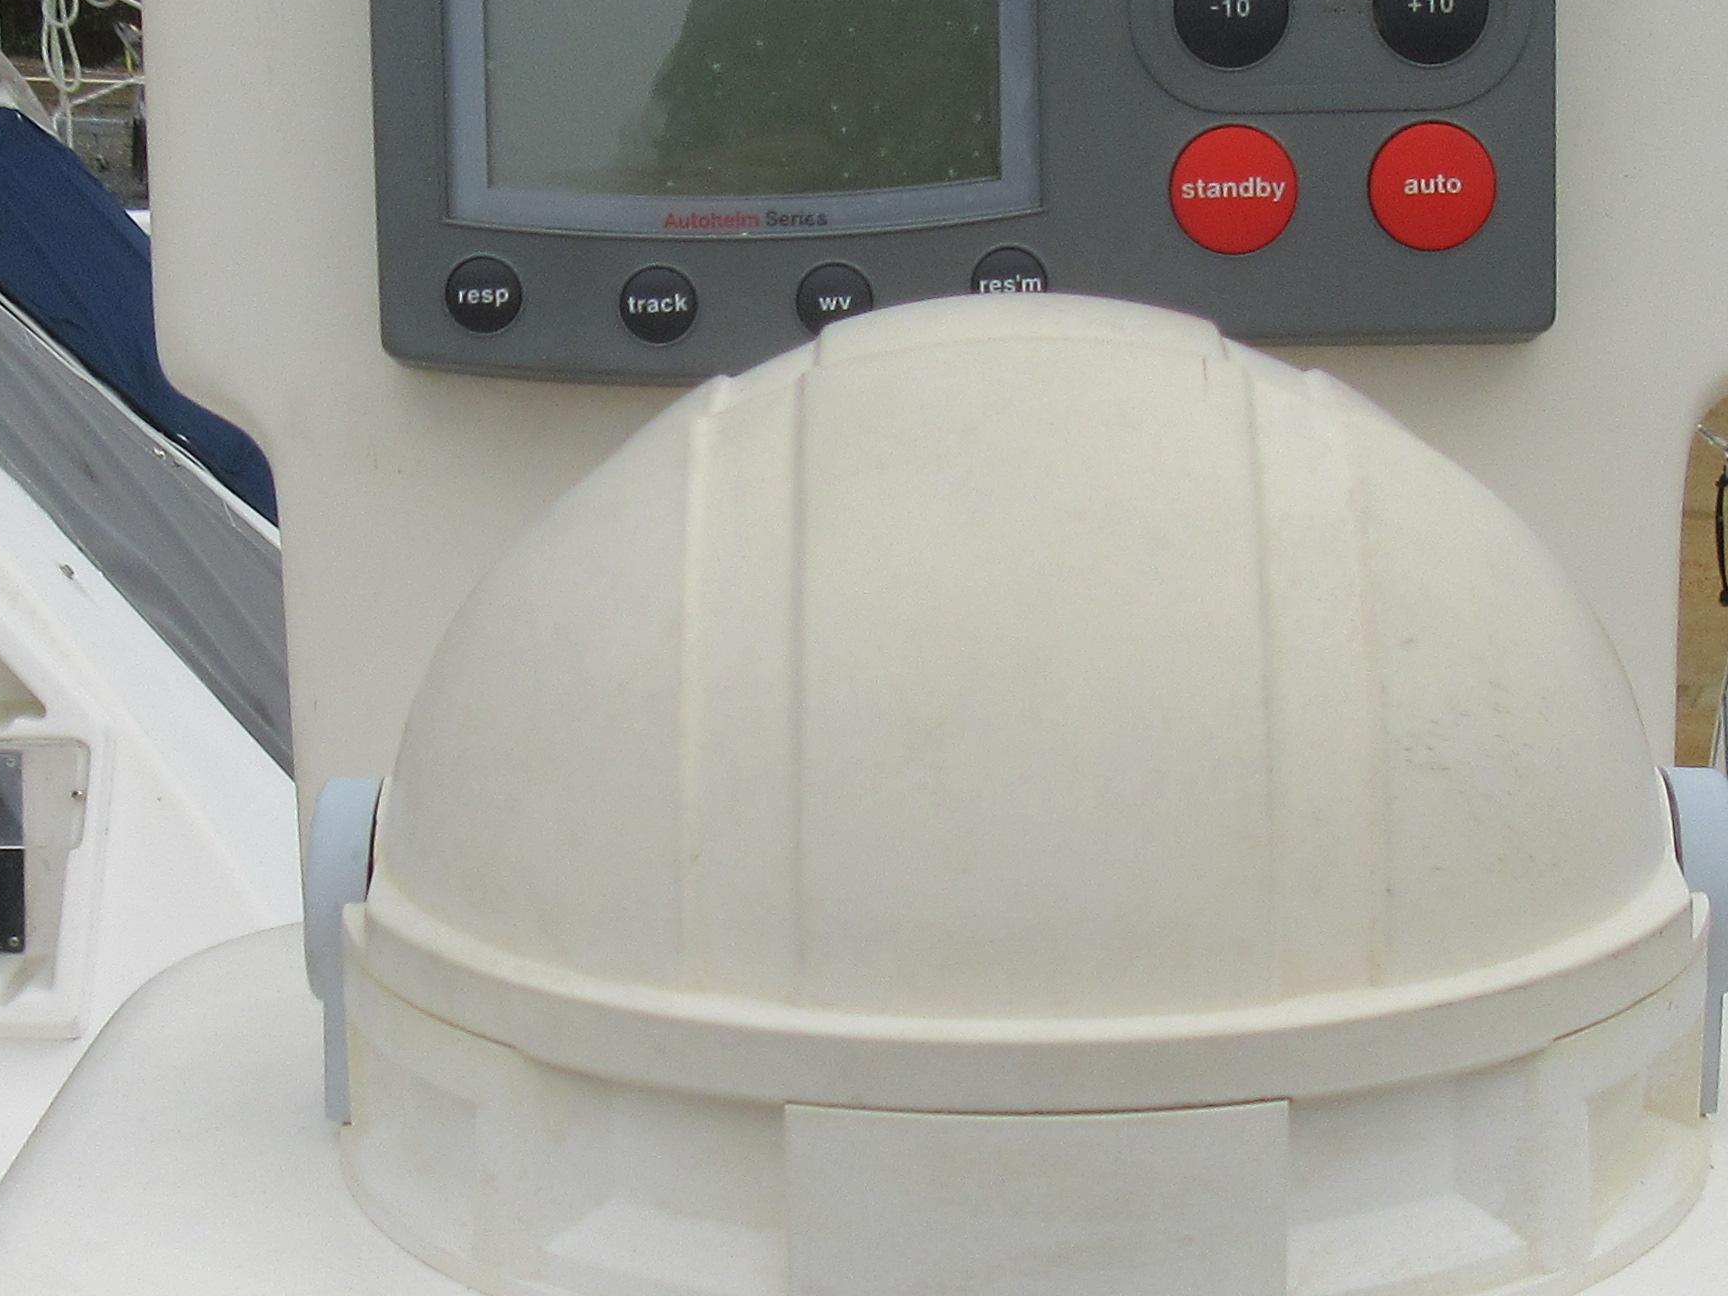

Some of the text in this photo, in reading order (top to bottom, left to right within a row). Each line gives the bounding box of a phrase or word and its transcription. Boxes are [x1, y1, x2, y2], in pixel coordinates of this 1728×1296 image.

[1181, 176, 1286, 202] standby
[1404, 174, 1463, 195] auto
[664, 209, 829, 230] Autohelm Series
[979, 274, 1042, 294] res'm
[458, 286, 510, 307] resp
[627, 292, 689, 314] track
[819, 295, 852, 311] wv
